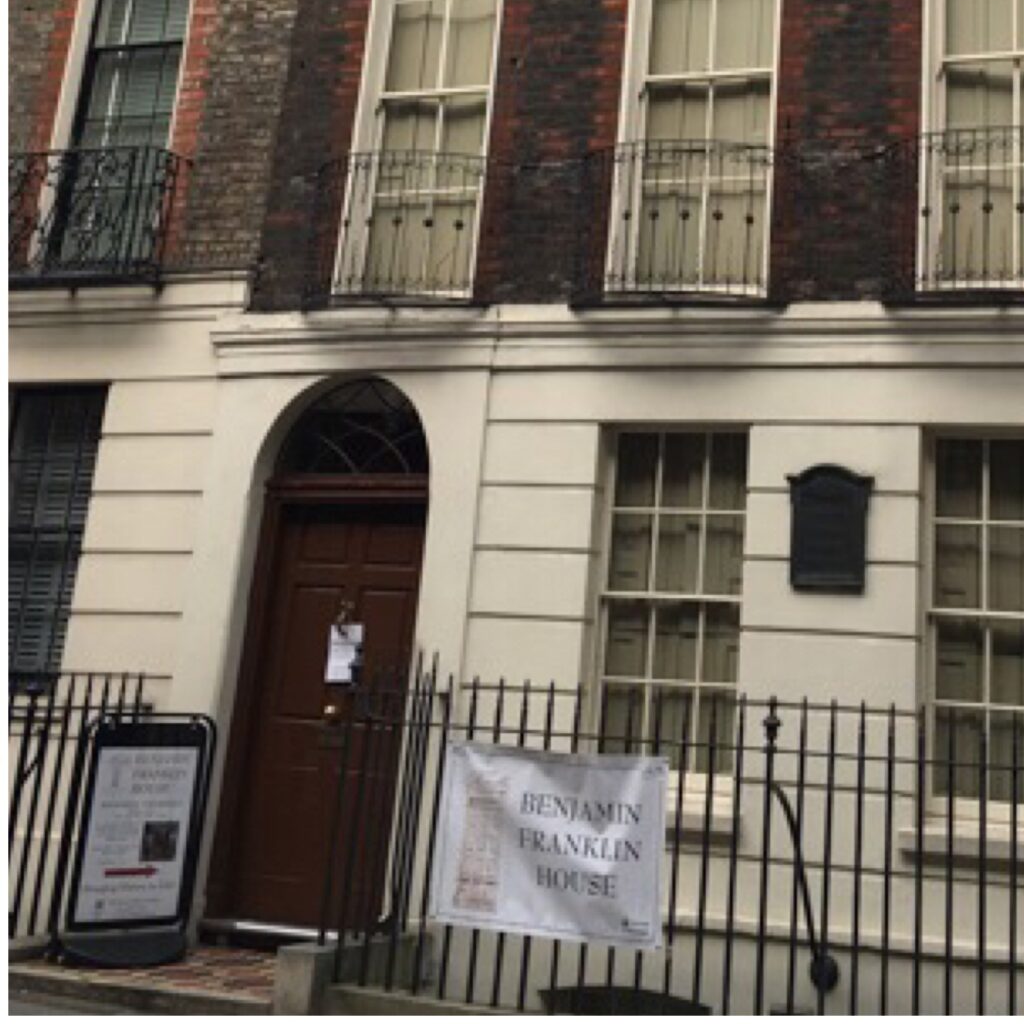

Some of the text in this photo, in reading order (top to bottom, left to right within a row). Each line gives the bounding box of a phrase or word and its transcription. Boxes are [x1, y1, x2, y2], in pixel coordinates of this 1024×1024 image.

[520, 792, 642, 825] BENJAMIN
[518, 828, 642, 862] FRANKLIN
[536, 865, 617, 898] HOUSE
